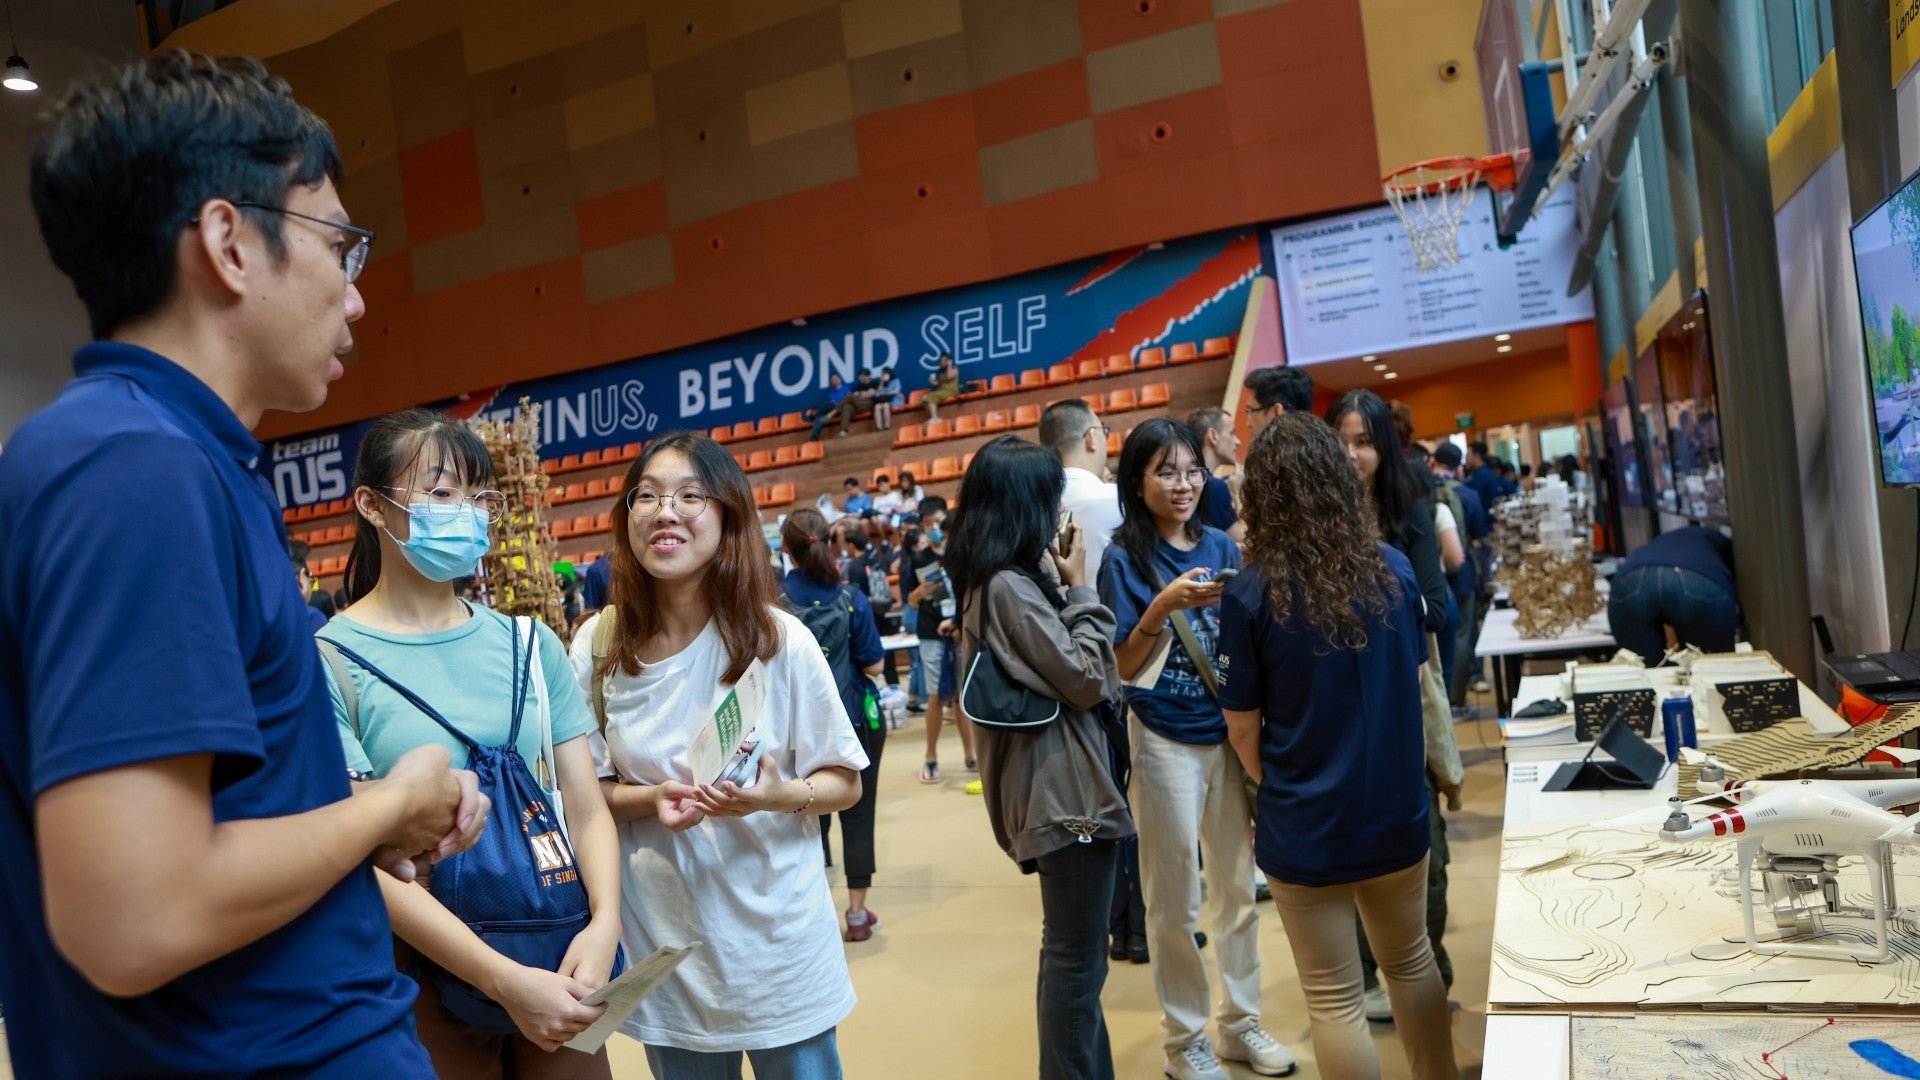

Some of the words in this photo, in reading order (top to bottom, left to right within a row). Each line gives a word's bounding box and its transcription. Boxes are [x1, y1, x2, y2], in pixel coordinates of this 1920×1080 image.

[1895, 0, 1920, 40] Lands
[1281, 223, 1355, 243] PROGRAMME
[678, 327, 899, 418] BEYOND
[919, 294, 1046, 371] SELF
[272, 433, 340, 462] team
[273, 450, 346, 508] NUS
